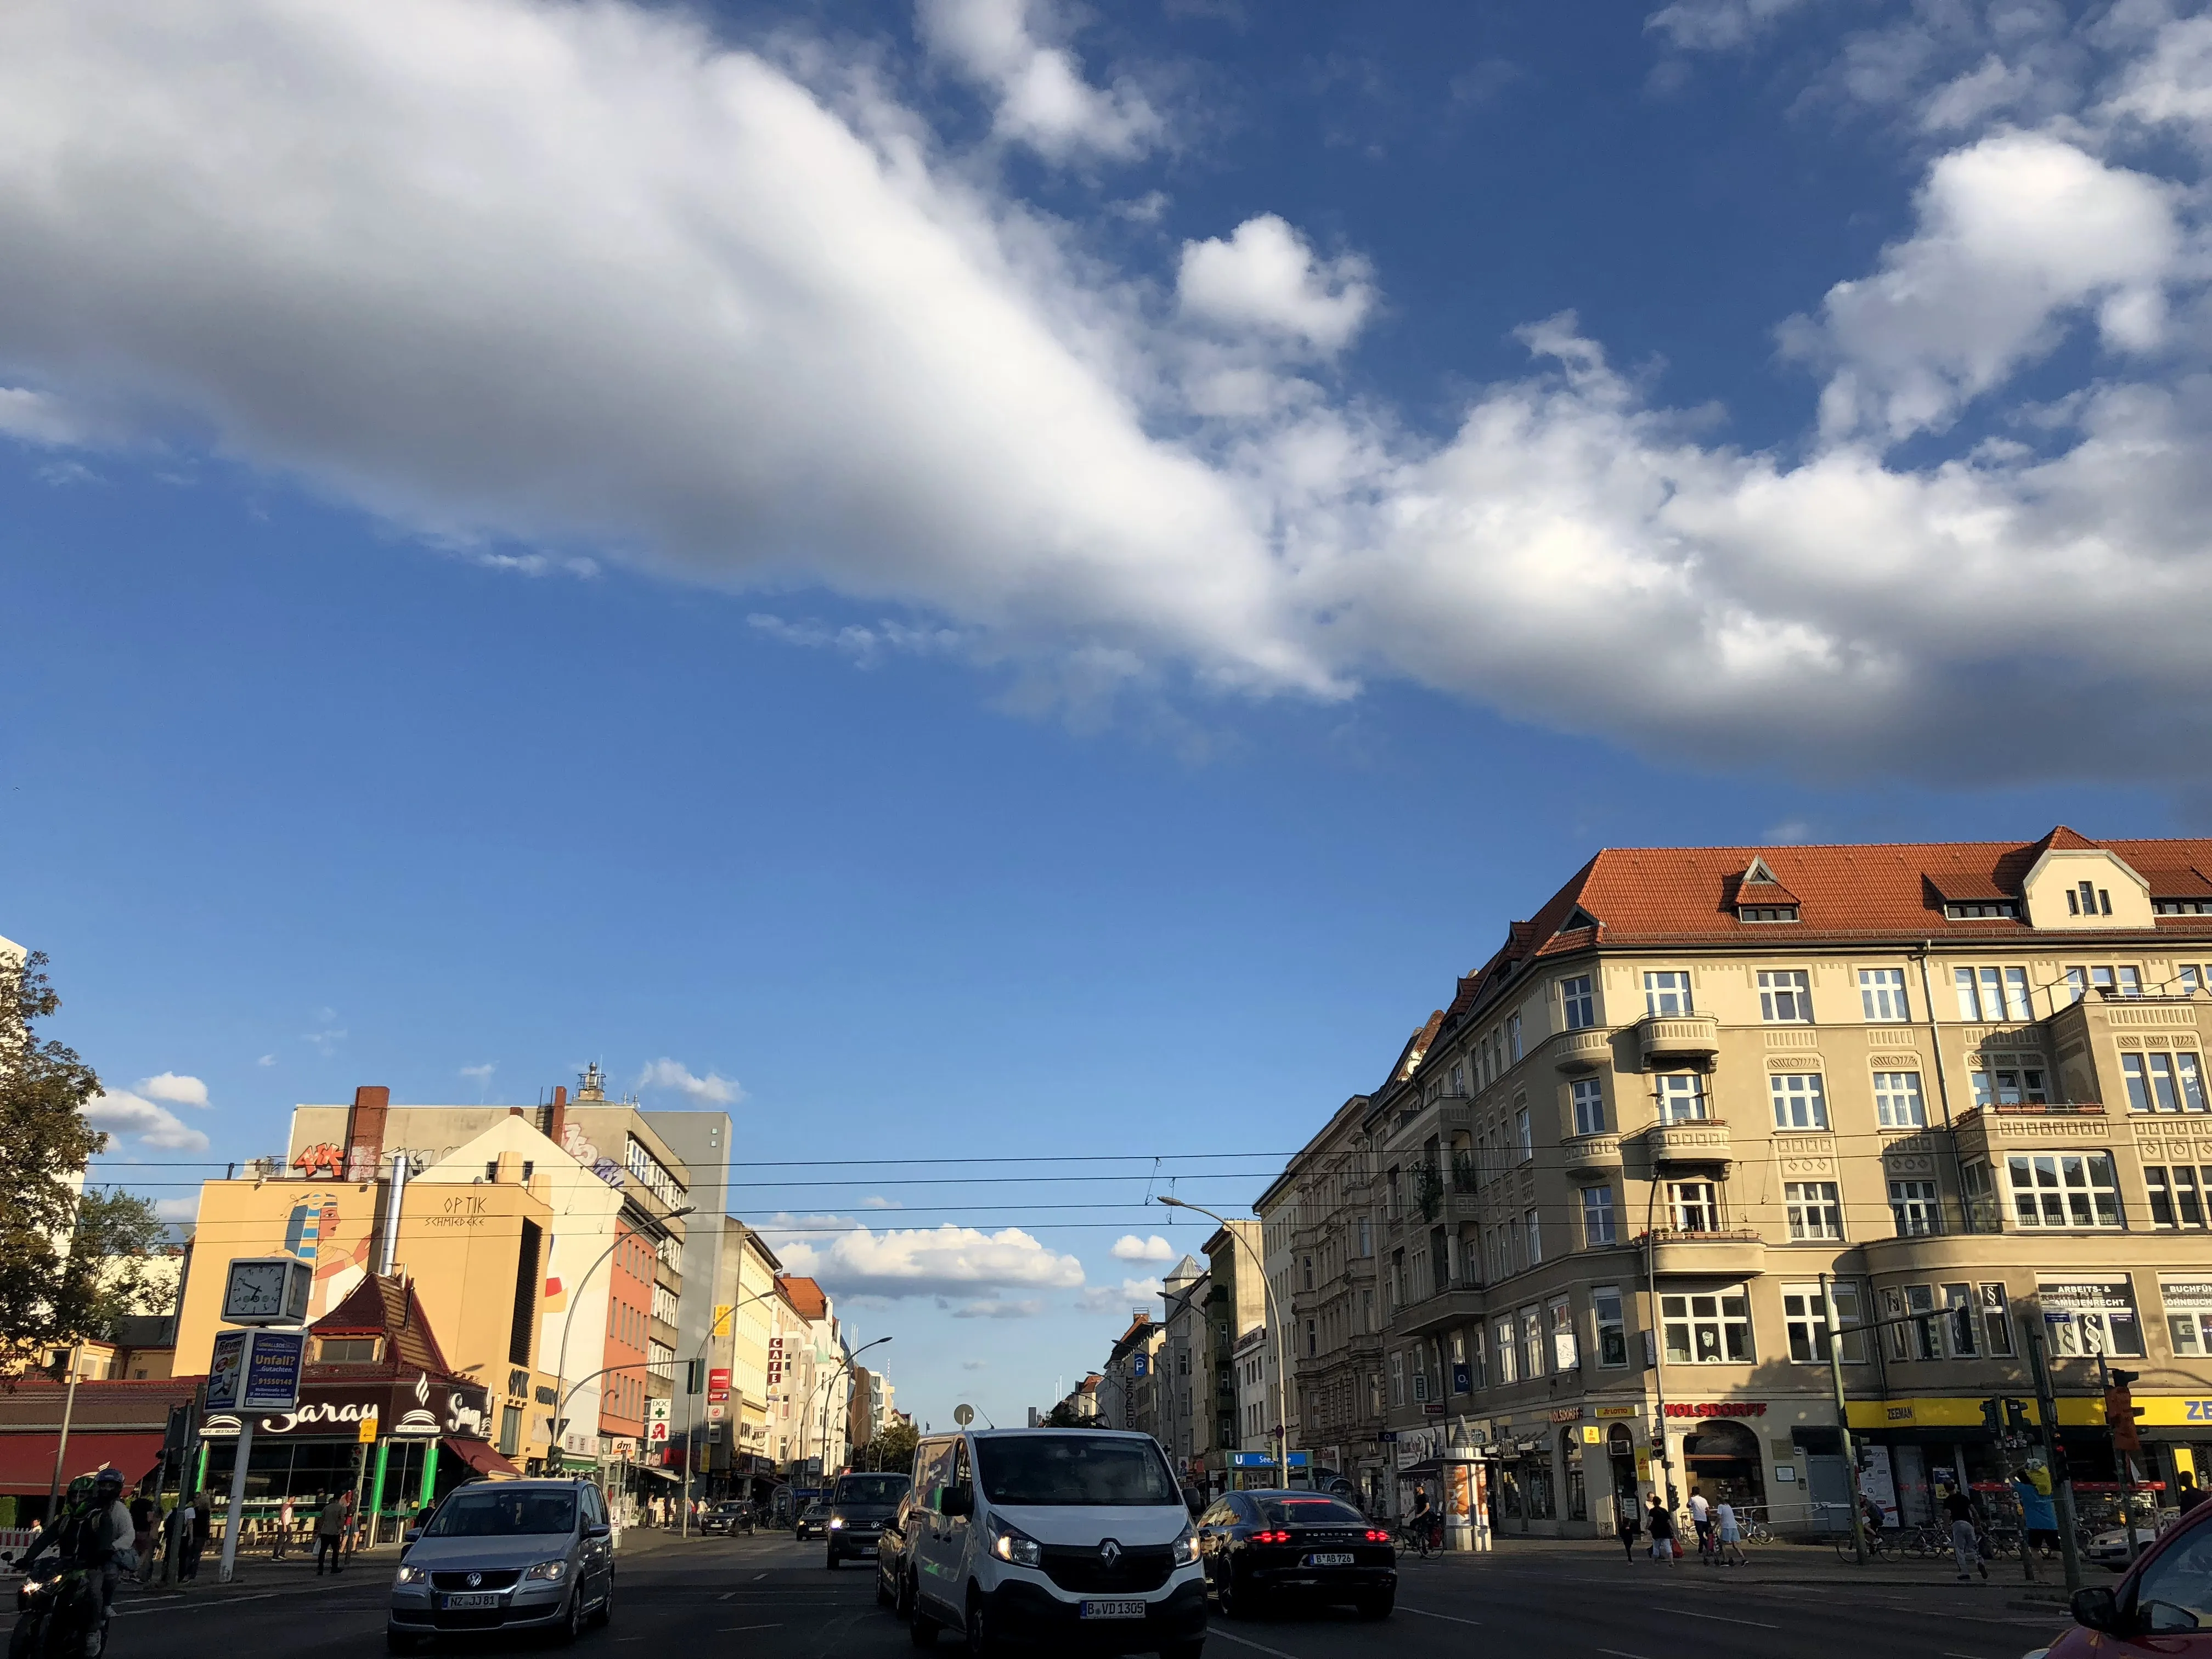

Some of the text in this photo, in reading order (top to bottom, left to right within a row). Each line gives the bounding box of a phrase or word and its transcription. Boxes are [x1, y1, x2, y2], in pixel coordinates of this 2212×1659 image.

[444, 1197, 487, 1214] OPTIK
[425, 1218, 485, 1226] SCHMIEDEKE
[256, 1355, 296, 1365] Unfall?
[772, 1339, 780, 1382] CAFE
[1136, 1362, 1144, 1372] P
[1887, 1406, 1913, 1420] ZEEMAN
[617, 1441, 631, 1449] dm
[1235, 1454, 1243, 1465] U
[1327, 1554, 1336, 1562] AB
[1338, 1554, 1351, 1562] 726
[451, 1595, 495, 1607] NZ JJ 81
[1088, 1602, 1143, 1614] B VD 1305
